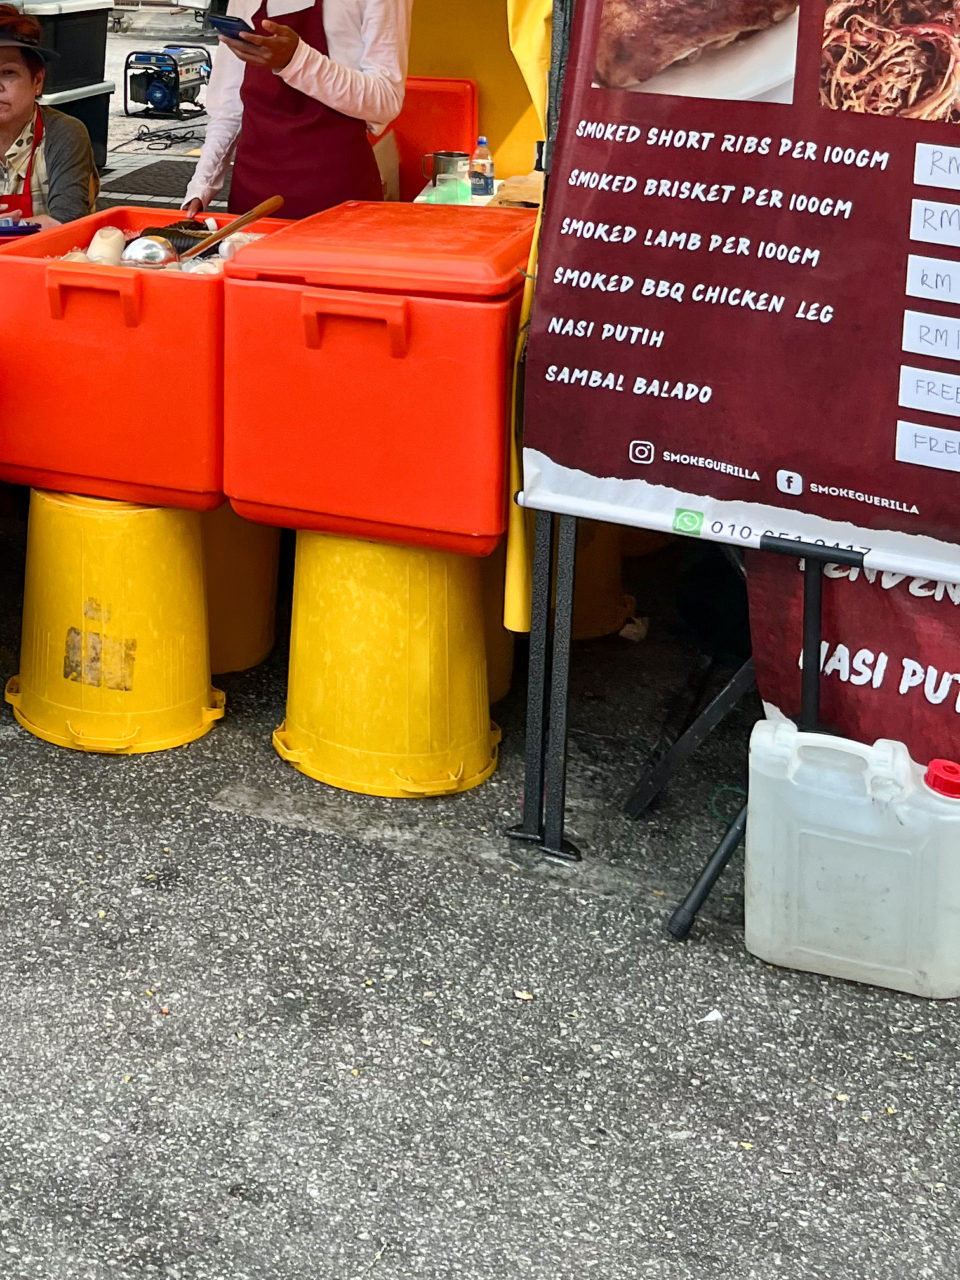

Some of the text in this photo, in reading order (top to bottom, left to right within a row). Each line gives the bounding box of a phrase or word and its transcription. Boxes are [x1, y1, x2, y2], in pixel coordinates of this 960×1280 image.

[575, 120, 641, 145] SMOKED
[646, 128, 713, 152] SHORT
[720, 135, 771, 156] RIBS
[778, 140, 817, 161] PER
[568, 168, 638, 195] SMOKED
[643, 178, 736, 205] BRISKET
[741, 188, 784, 210] PER
[560, 217, 637, 244] SMOKED
[643, 228, 702, 252] LAMB
[709, 235, 750, 257] PER
[923, 207, 960, 231] RM
[553, 267, 835, 324] SMOKED BBQ CHICKEN LEG
[548, 317, 665, 349] NASI PUTIH
[919, 325, 949, 347] RM
[545, 365, 713, 405] SAMBAL BALADO
[662, 450, 761, 481] SMOKEGUERILLA
[809, 482, 920, 515] SMOKEGUERILLA
